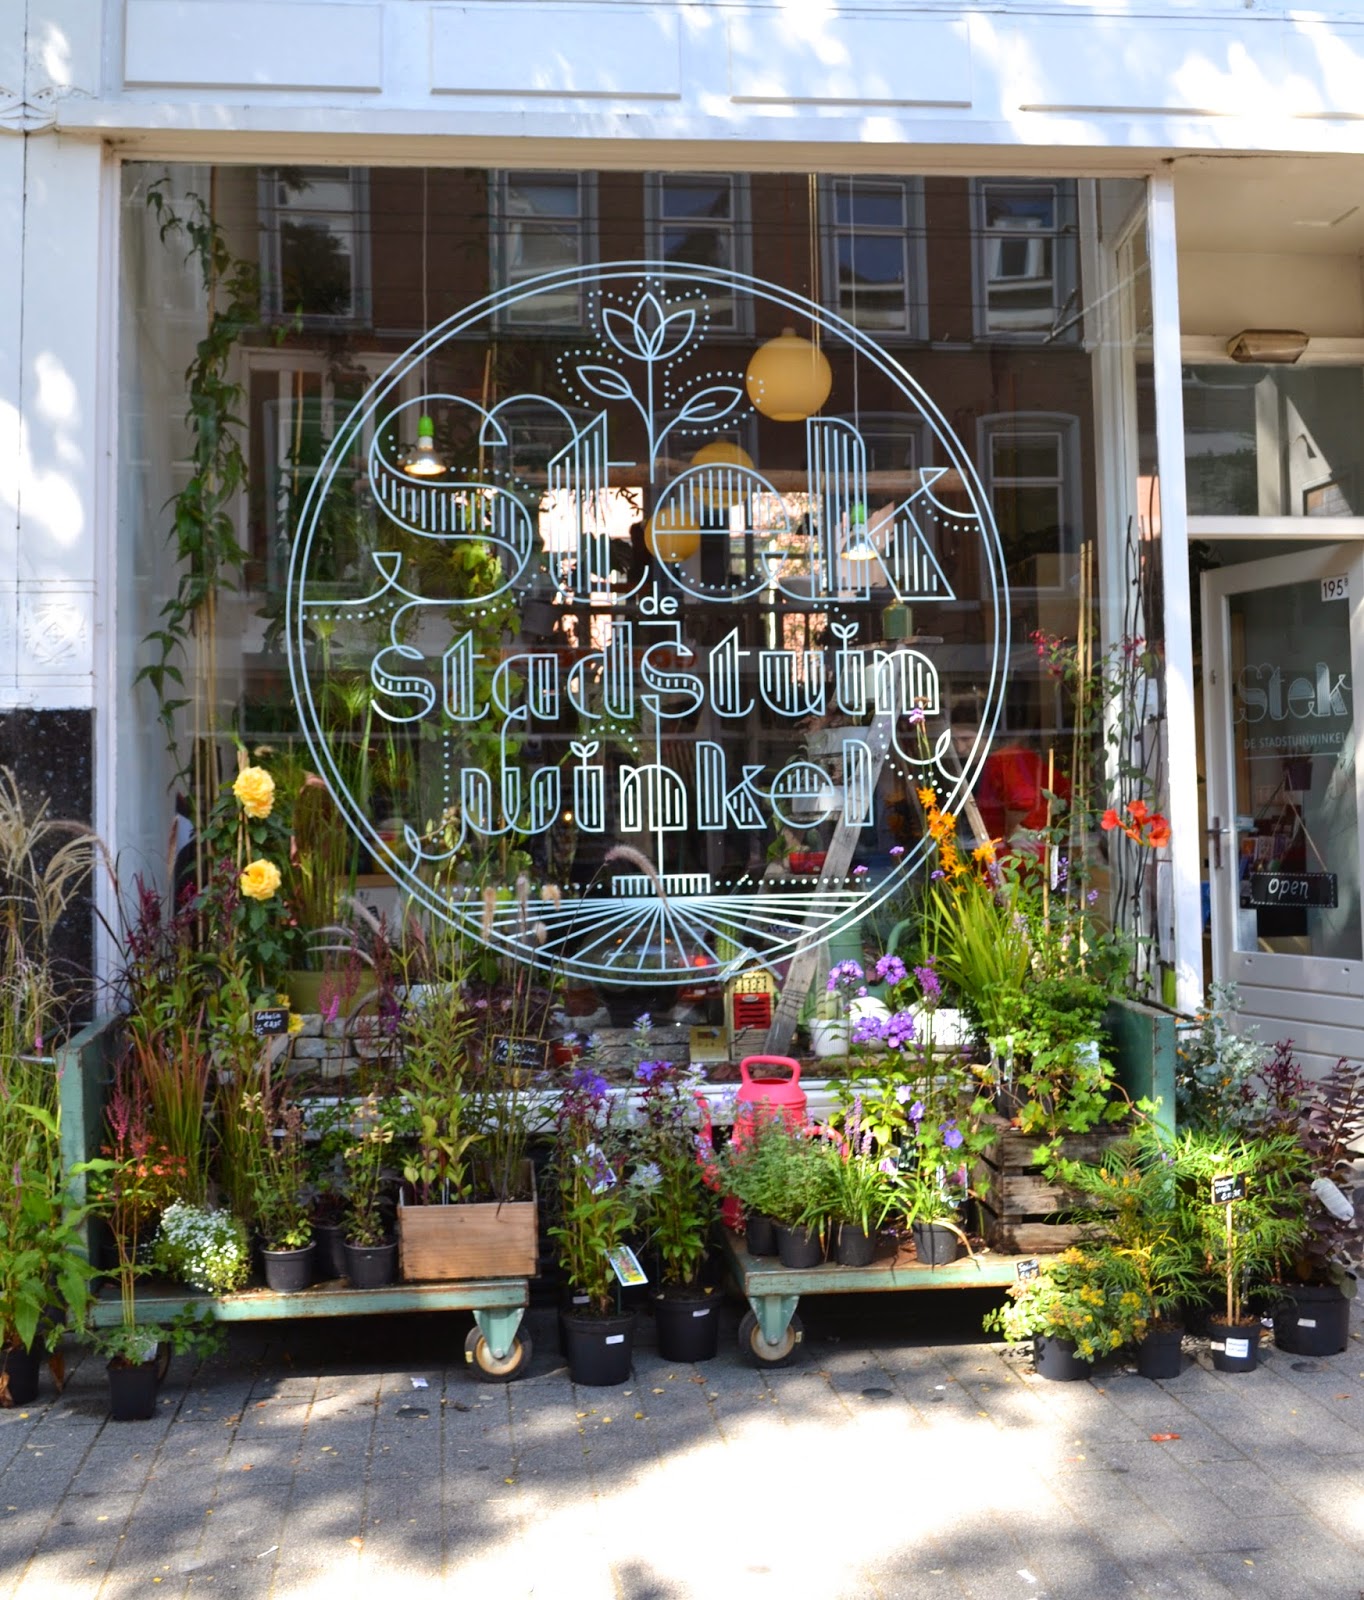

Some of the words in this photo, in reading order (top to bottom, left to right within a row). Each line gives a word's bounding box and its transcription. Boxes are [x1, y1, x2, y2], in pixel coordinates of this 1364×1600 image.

[368, 393, 956, 602] Stek
[639, 580, 679, 616] de
[1238, 662, 1349, 722] Stek
[1243, 738, 1256, 750] DE
[1258, 732, 1347, 748] STADSTUINWINKEL
[460, 739, 874, 835] winkel
